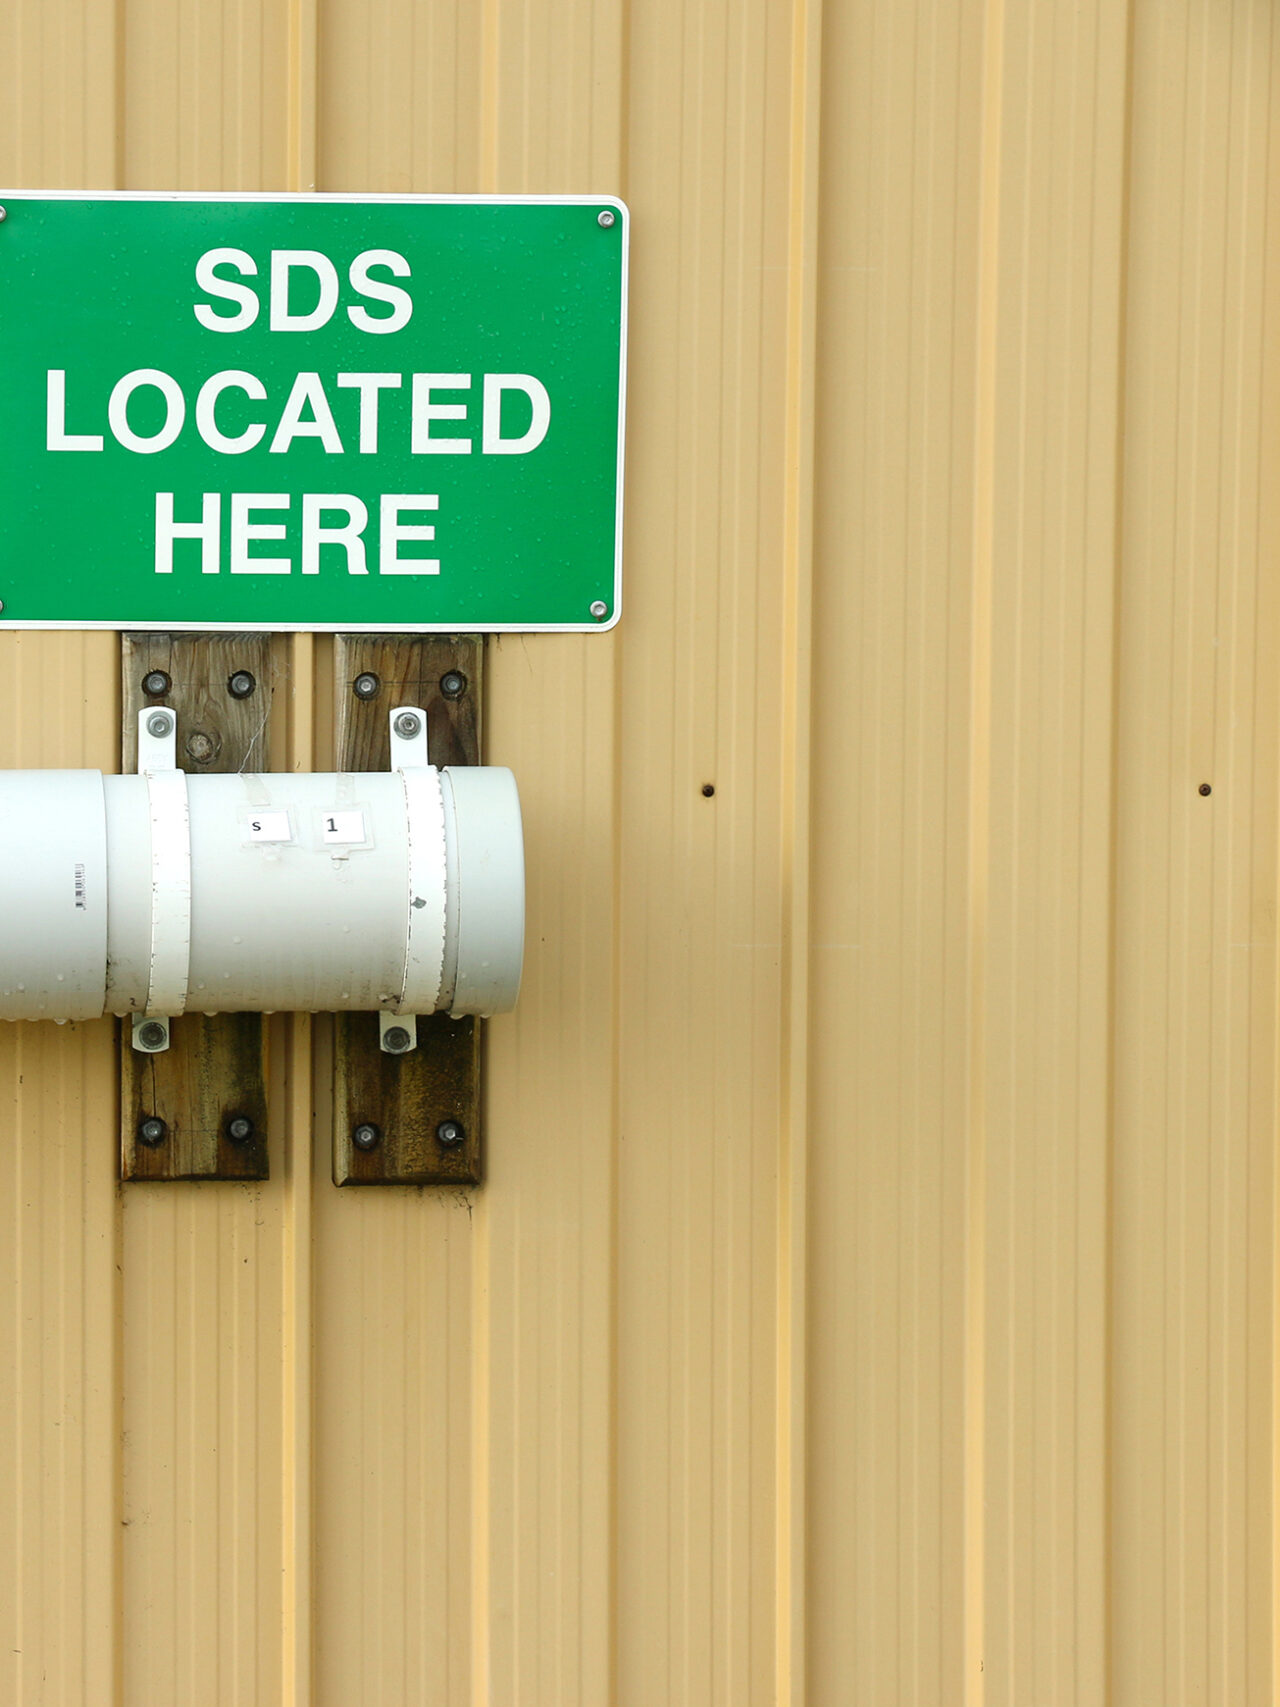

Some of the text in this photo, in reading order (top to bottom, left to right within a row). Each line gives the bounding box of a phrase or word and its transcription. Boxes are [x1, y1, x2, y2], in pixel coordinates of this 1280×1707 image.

[193, 247, 413, 333] SDS
[46, 369, 551, 455] LOCATED
[154, 492, 440, 575] HERE
[327, 817, 338, 832] 1
